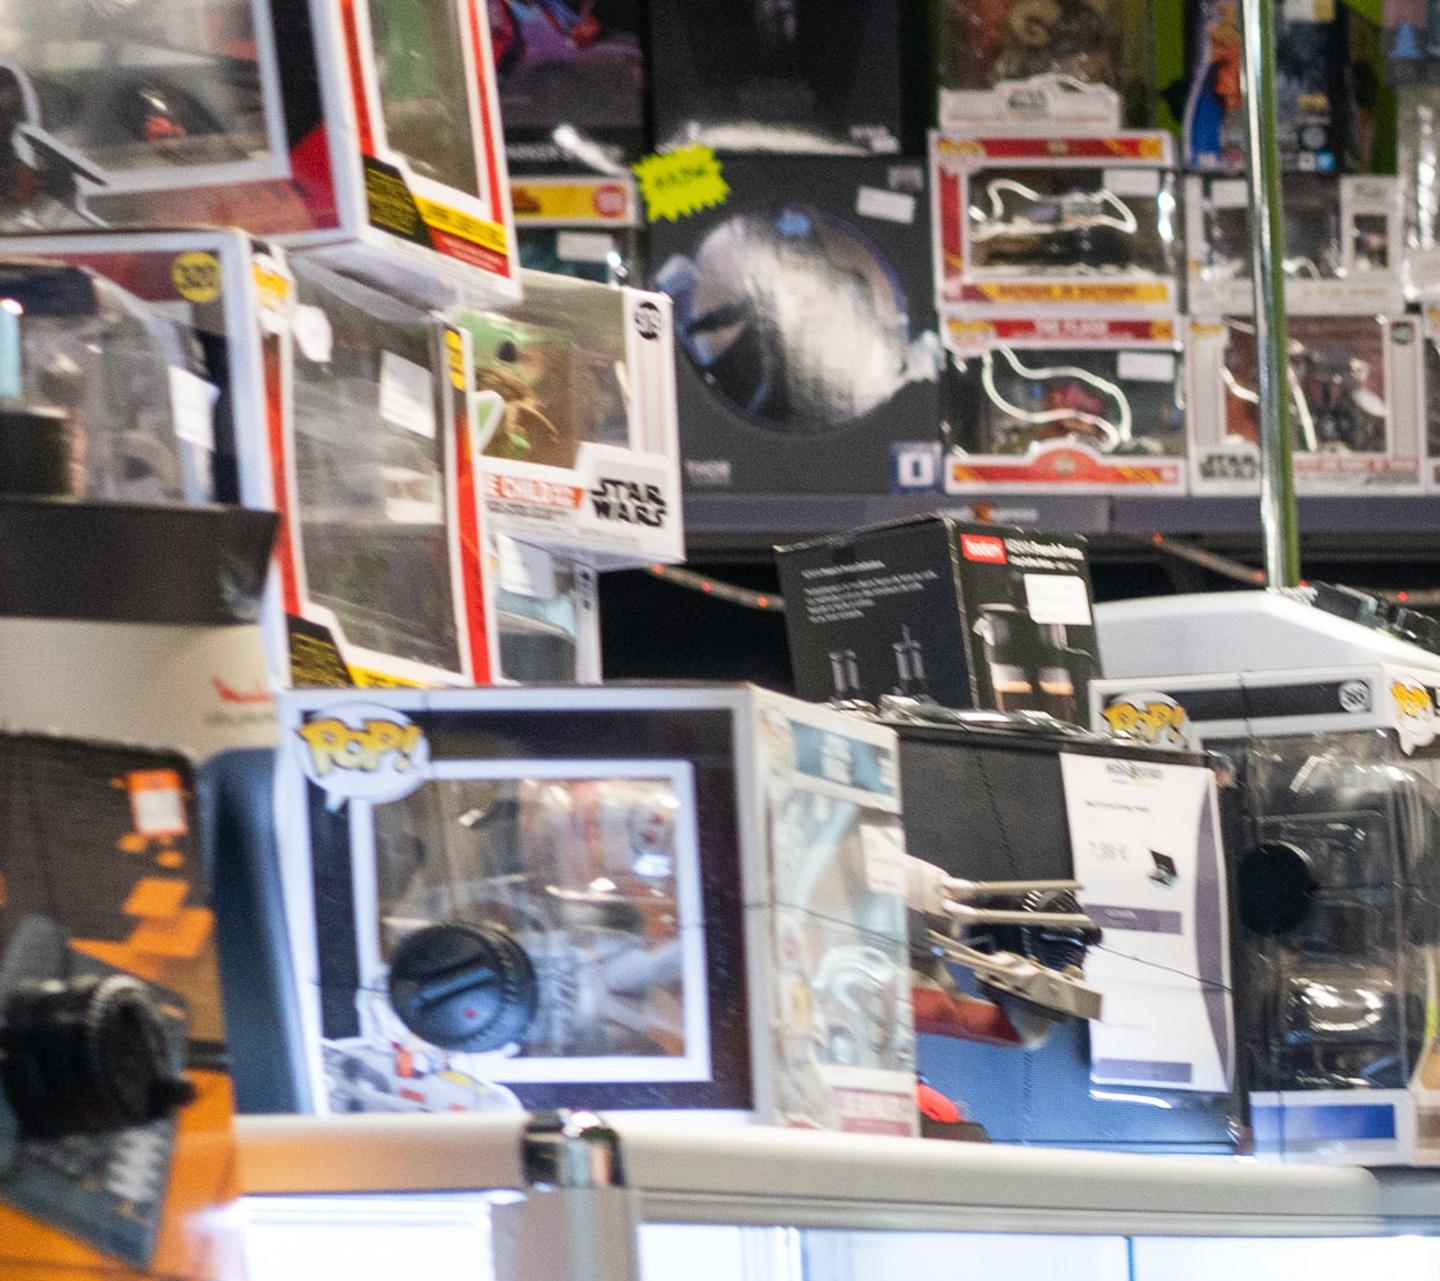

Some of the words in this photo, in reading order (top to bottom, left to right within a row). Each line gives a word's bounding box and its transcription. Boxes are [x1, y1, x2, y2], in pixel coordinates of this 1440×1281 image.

[595, 477, 668, 508] STAR
[597, 498, 669, 530] WARS
[298, 718, 428, 776] POP!
